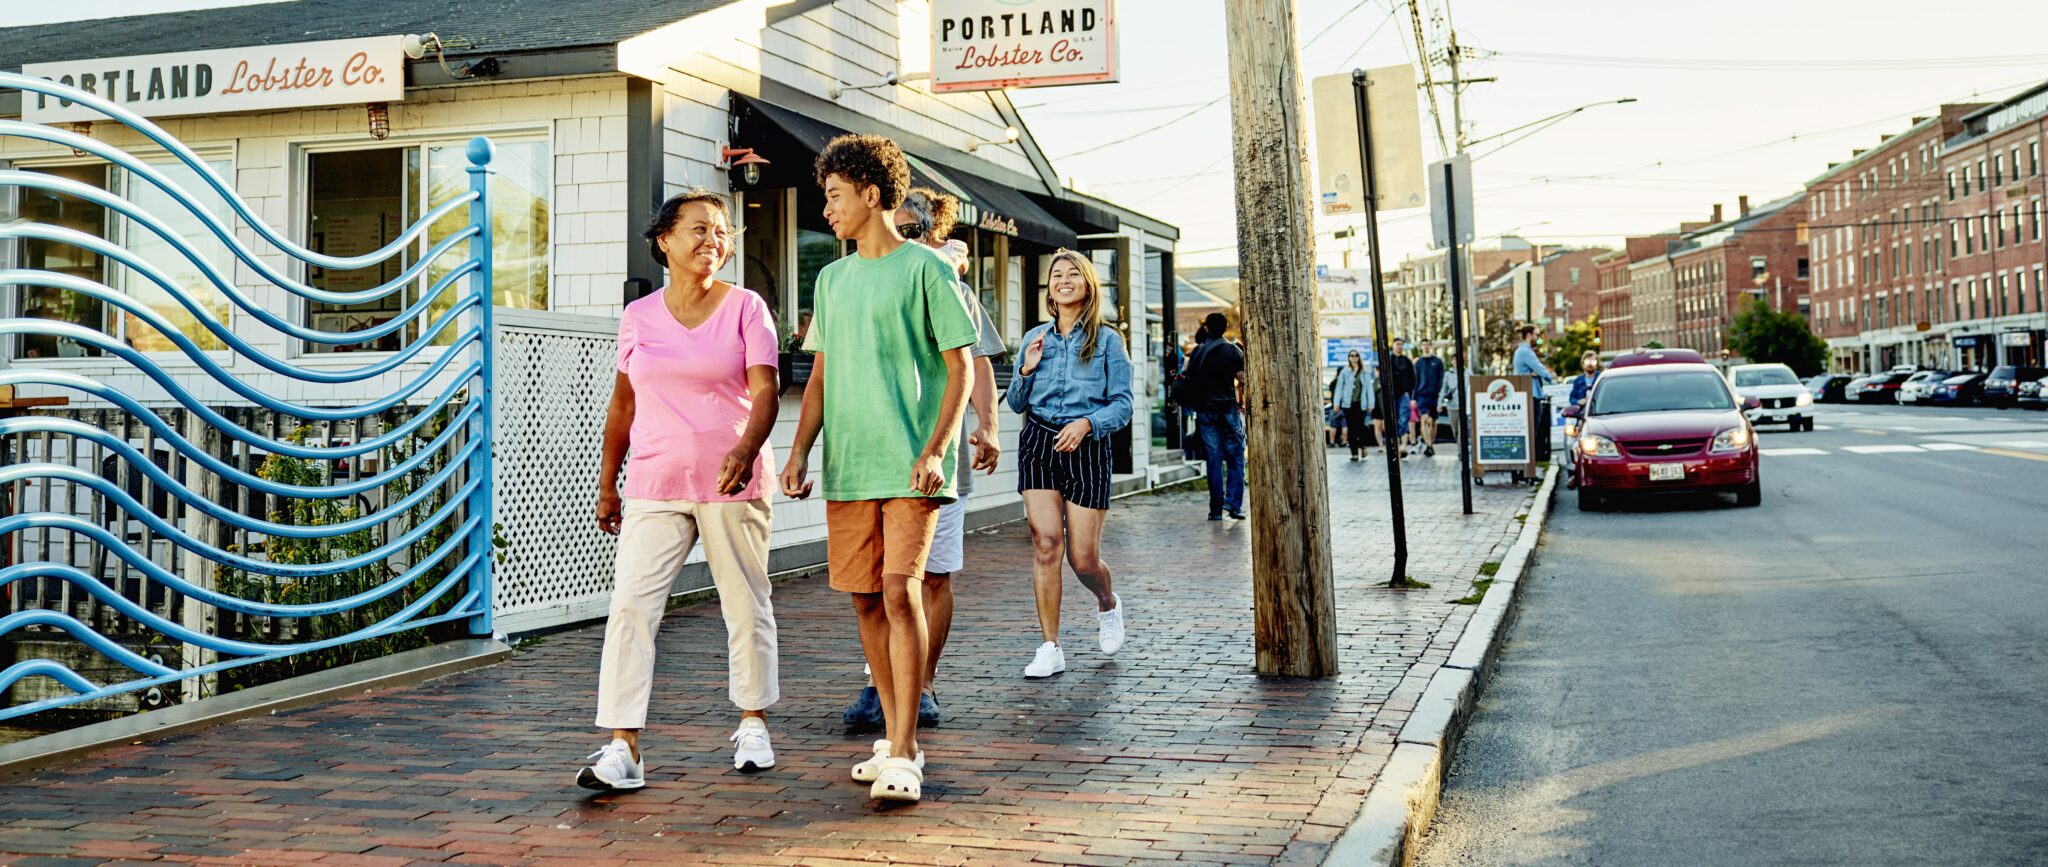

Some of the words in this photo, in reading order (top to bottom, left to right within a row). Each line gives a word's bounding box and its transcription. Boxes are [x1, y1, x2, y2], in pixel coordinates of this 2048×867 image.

[942, 8, 1096, 42] PORTLAND
[955, 43, 1044, 70] Lobster
[1050, 39, 1085, 63] Co.
[221, 57, 335, 95] Lobster
[342, 51, 386, 87] Co.
